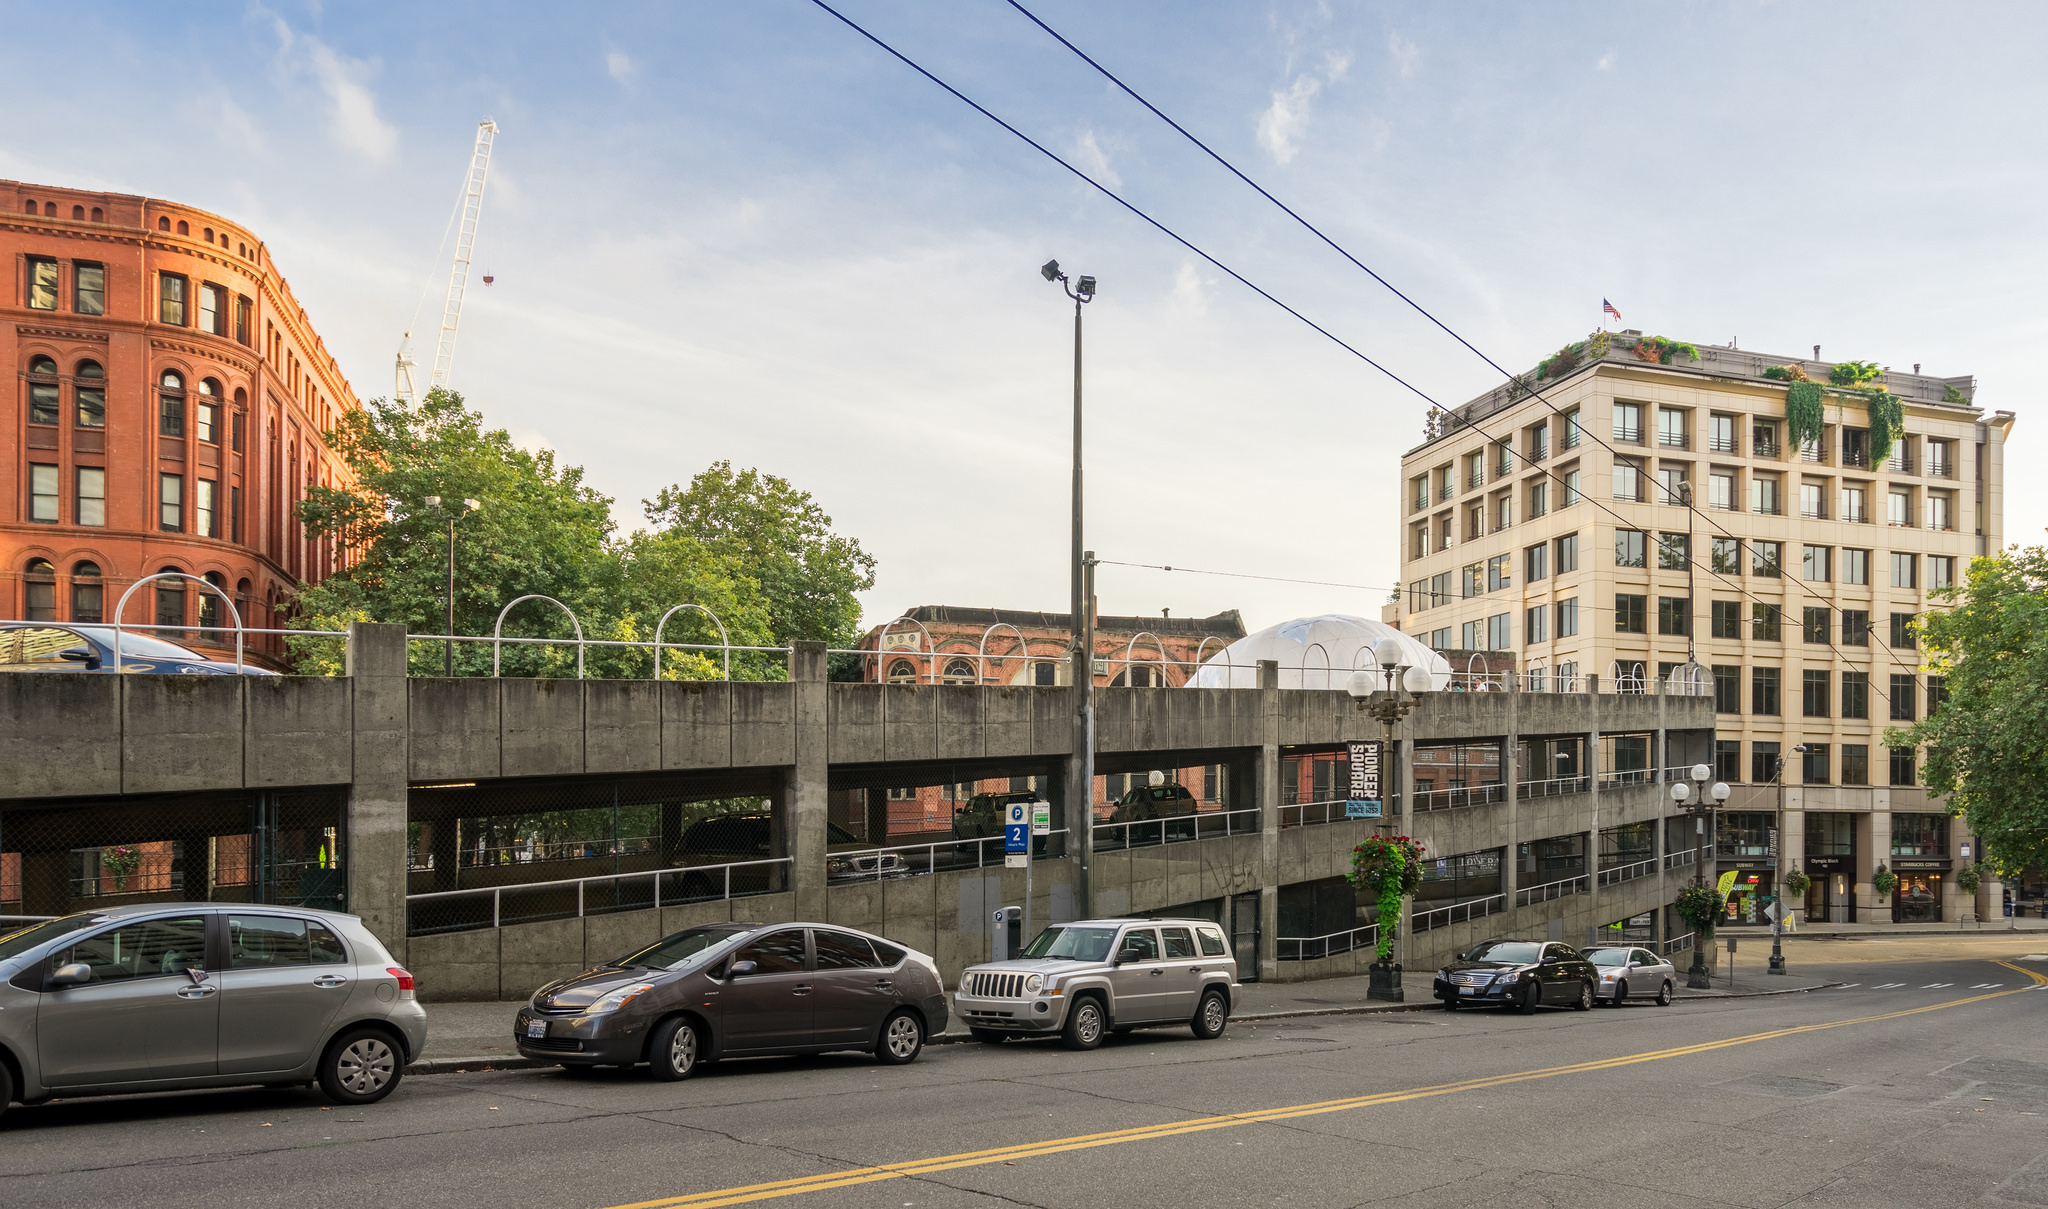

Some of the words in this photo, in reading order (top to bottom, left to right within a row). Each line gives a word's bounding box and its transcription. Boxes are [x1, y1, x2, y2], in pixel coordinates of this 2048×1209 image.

[1351, 744, 1364, 798] SQUARE
[1364, 744, 1378, 798] PIONEER
[1015, 809, 1021, 818] P
[1013, 827, 1021, 841] 2
[1732, 883, 1757, 891] SUBWAY
